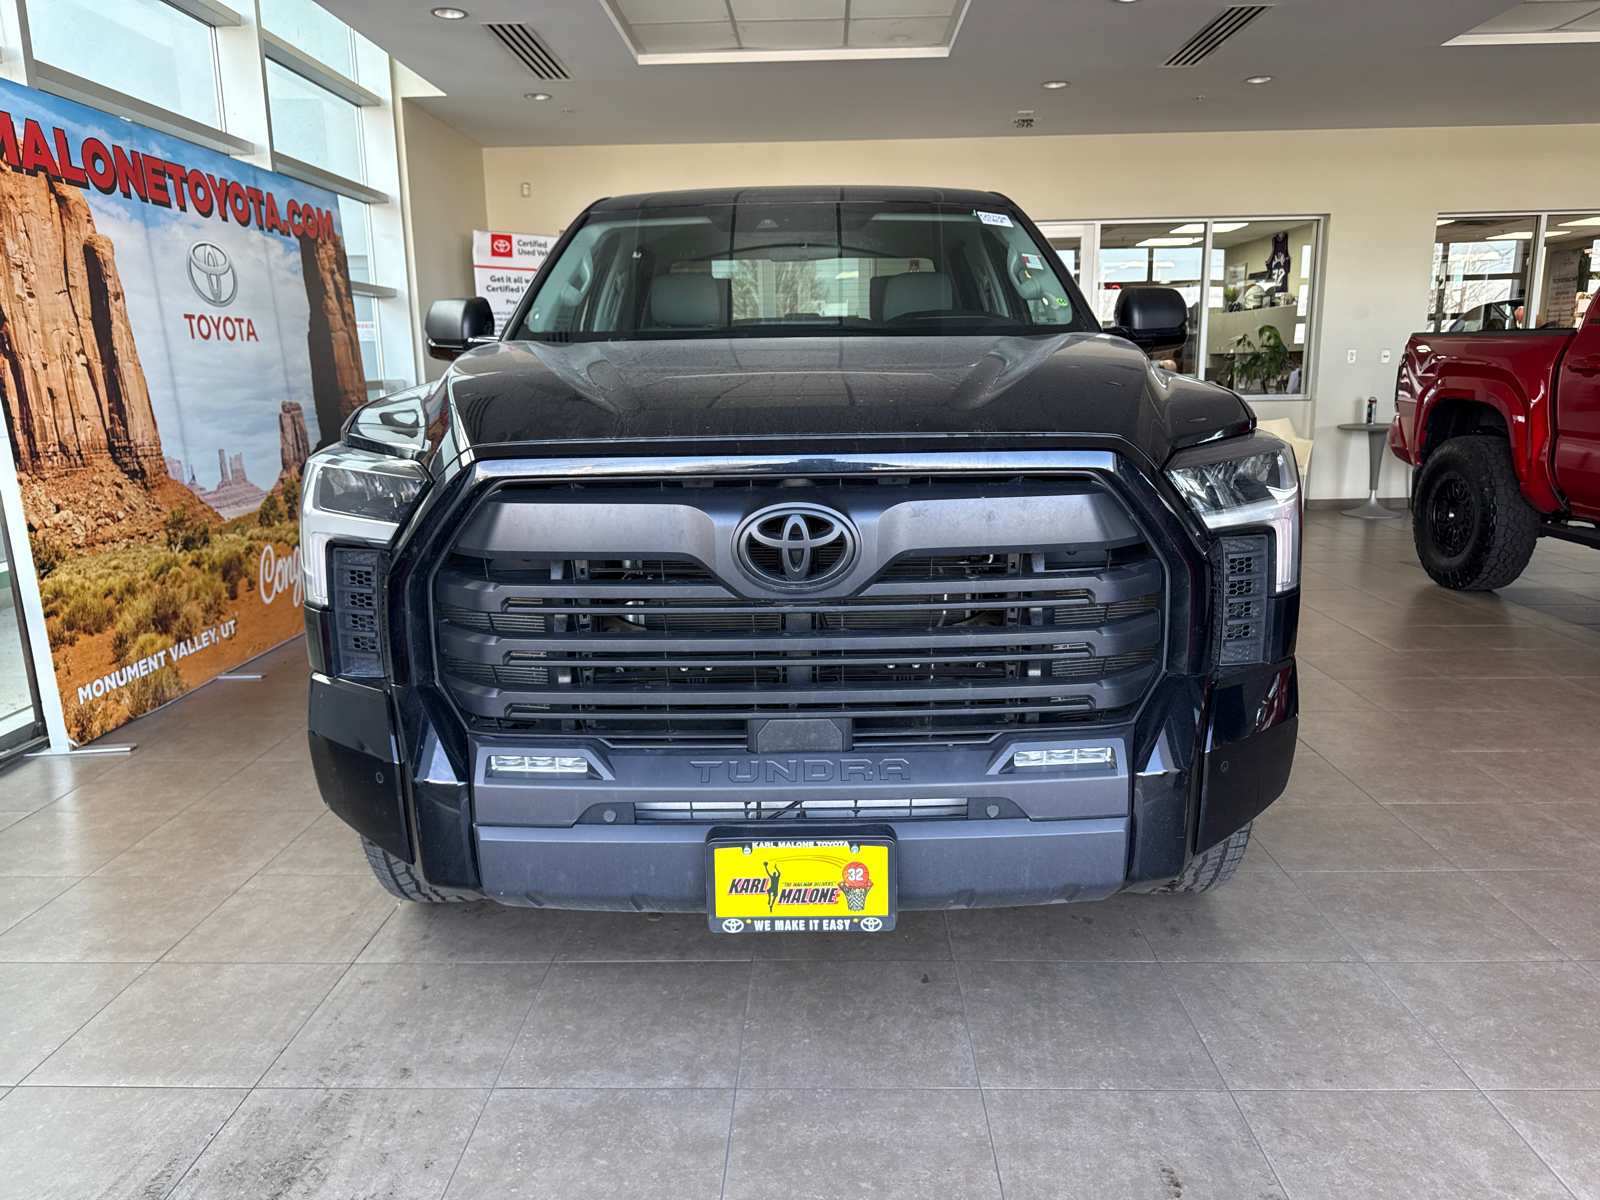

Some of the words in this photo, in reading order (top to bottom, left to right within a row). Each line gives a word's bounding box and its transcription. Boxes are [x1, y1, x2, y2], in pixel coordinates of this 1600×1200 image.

[517, 239, 548, 248] Certified
[517, 248, 536, 256] Used
[490, 275, 505, 283] Get
[506, 275, 512, 283] it
[513, 276, 523, 284] all
[486, 284, 520, 293] Certified
[183, 313, 259, 342] TOYOTA
[77, 650, 166, 705] MONUMENT
[169, 628, 221, 662] VALLEY,
[221, 620, 237, 641] UT
[690, 758, 911, 783] TUNDRA
[847, 868, 864, 881] 32
[728, 878, 769, 895] KARL
[777, 888, 840, 905] MALONE
[754, 920, 772, 931] WE
[775, 919, 805, 931] MAKE
[809, 919, 819, 930] IT
[823, 919, 851, 931] EASY
